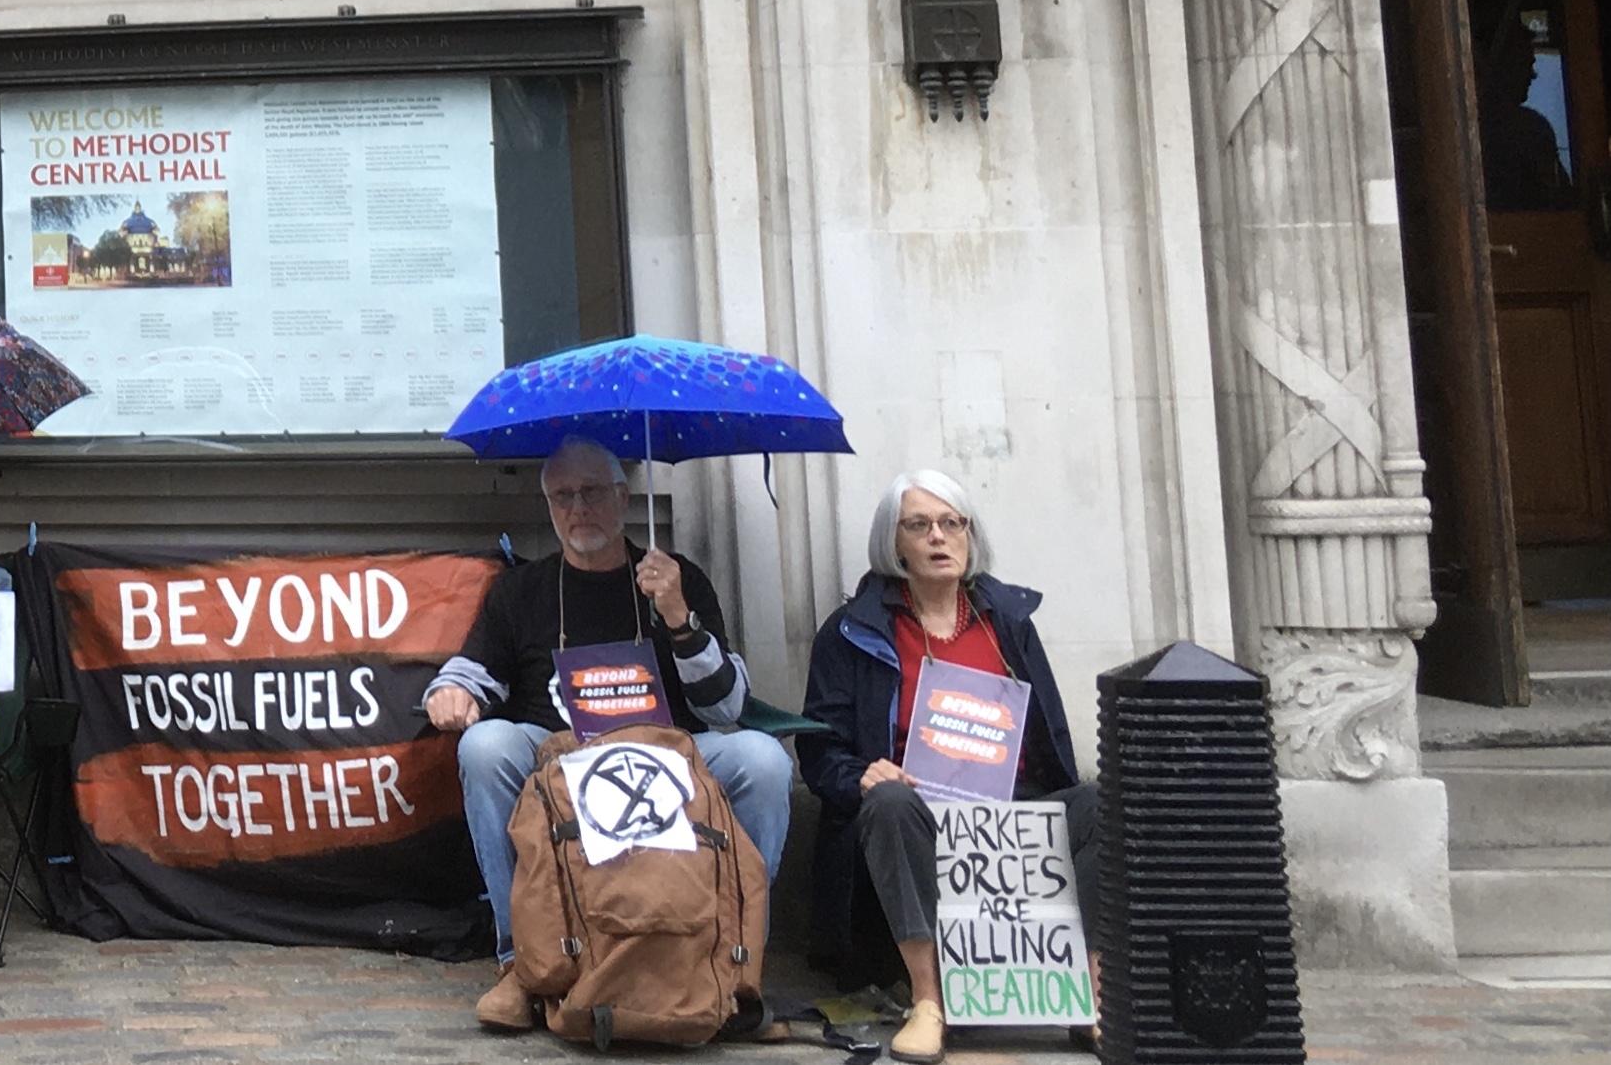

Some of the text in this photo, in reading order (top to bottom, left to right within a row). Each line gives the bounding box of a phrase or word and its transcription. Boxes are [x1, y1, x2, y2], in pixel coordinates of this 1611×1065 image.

[28, 106, 164, 132] WELCOME
[29, 131, 231, 159] TO METHODIST
[31, 158, 226, 186] CENTRAL HALL
[119, 569, 408, 651] BEYOND
[579, 684, 649, 697] FOSSIL FUELS
[583, 669, 638, 684] BEYOND
[123, 666, 380, 733] FOSSIL FUELS
[587, 698, 647, 710] TOGETHER
[940, 695, 1002, 722] BEYOND
[929, 713, 1006, 742] FOSSIL FUELS
[932, 732, 997, 760] TOGETHER
[141, 755, 415, 837] TOGETHER
[934, 806, 1062, 852] MARKET
[935, 852, 1068, 900] FORCES
[979, 897, 1032, 923] ARE
[938, 918, 1073, 968] KILLING
[944, 967, 1092, 1018] CREATION
